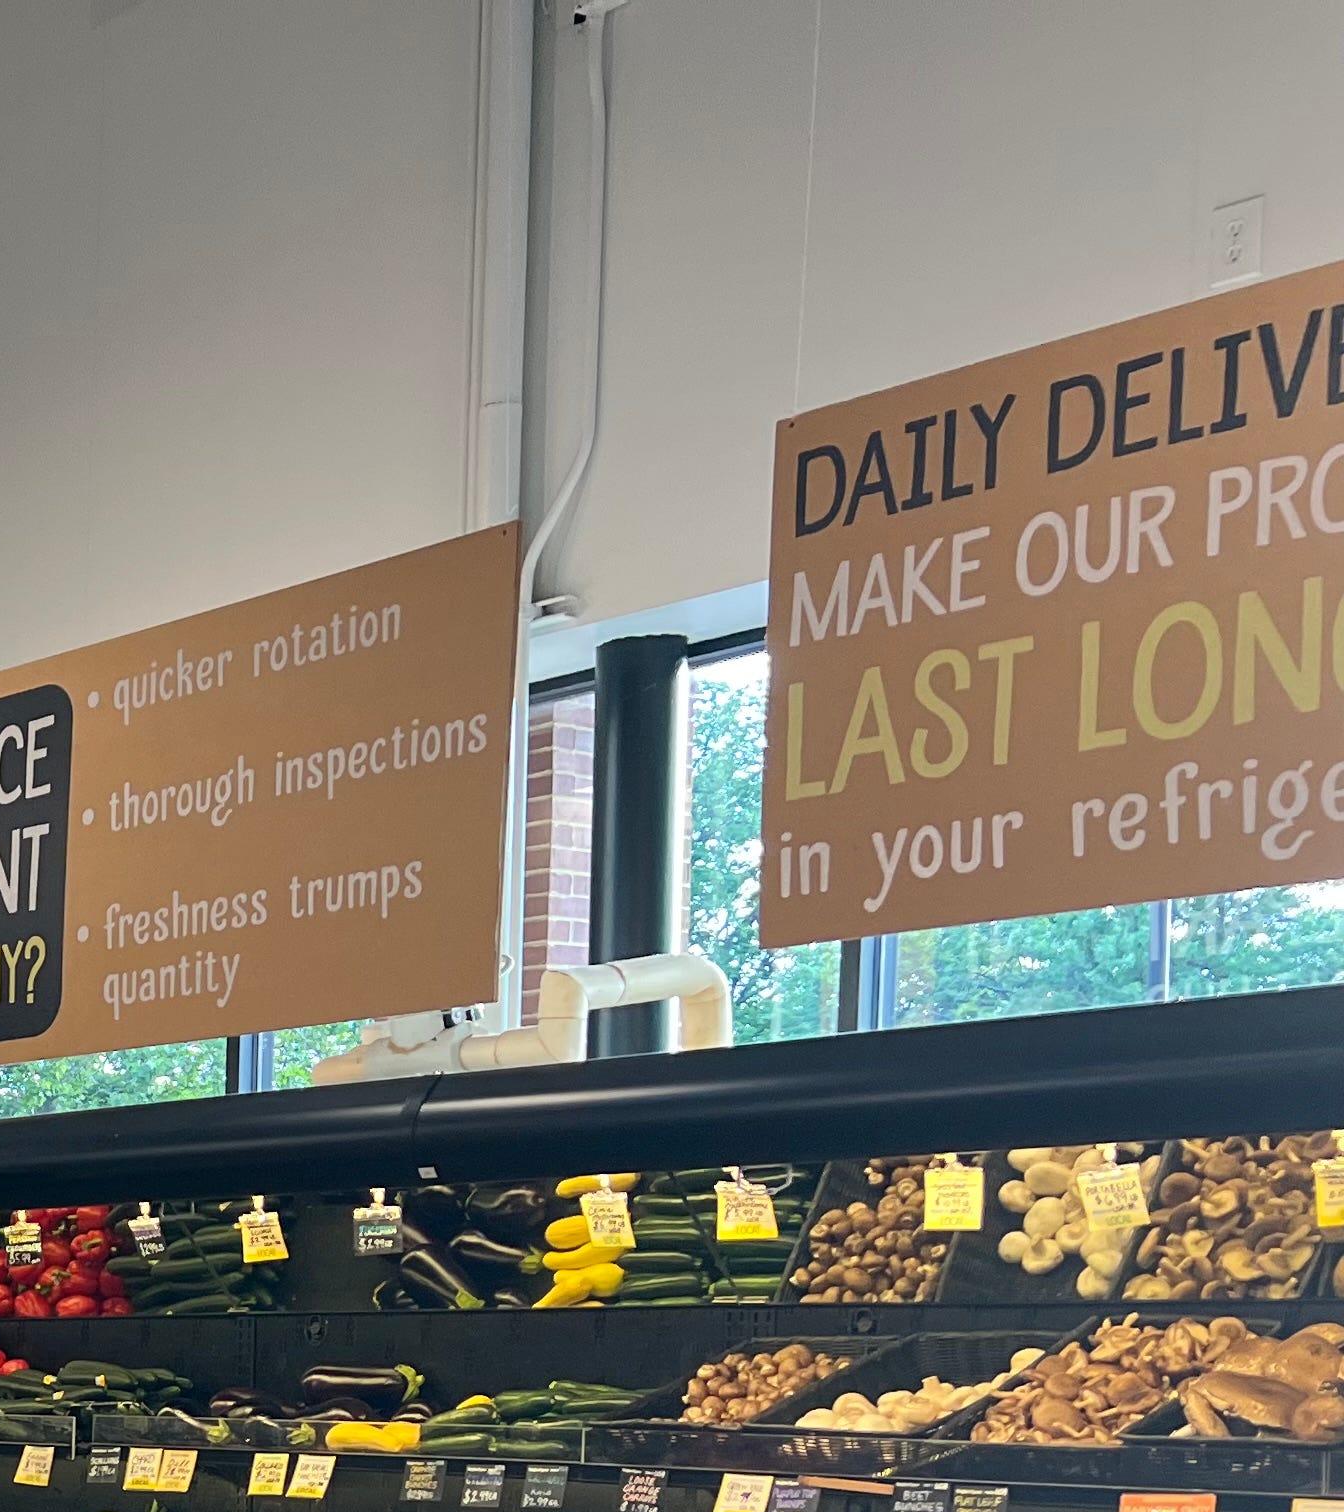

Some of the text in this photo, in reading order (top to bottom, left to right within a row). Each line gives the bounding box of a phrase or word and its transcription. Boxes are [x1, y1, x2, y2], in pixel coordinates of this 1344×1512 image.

[795, 394, 1017, 537] DAILY
[790, 526, 991, 647] MAKE
[1015, 485, 1176, 597] OUR
[113, 603, 402, 726] quicker rotation
[785, 576, 1344, 802] LAST LON
[108, 712, 489, 832] thorough inspections
[779, 832, 831, 898] in
[864, 810, 1024, 913] your
[104, 858, 424, 952] freshness trumps
[102, 952, 241, 1021] quantity
[940, 1216, 963, 1225] LOCAL
[736, 1225, 760, 1234] LOCAL
[131, 1478, 149, 1486] LOCAL
[628, 1475, 657, 1487] LOOSE
[462, 1488, 488, 1504] $2.99
[802, 1488, 817, 1499] TOP
[903, 1490, 934, 1502] BEET
[954, 1496, 976, 1507] FLAT
[894, 1501, 944, 1512] BUNCHES
